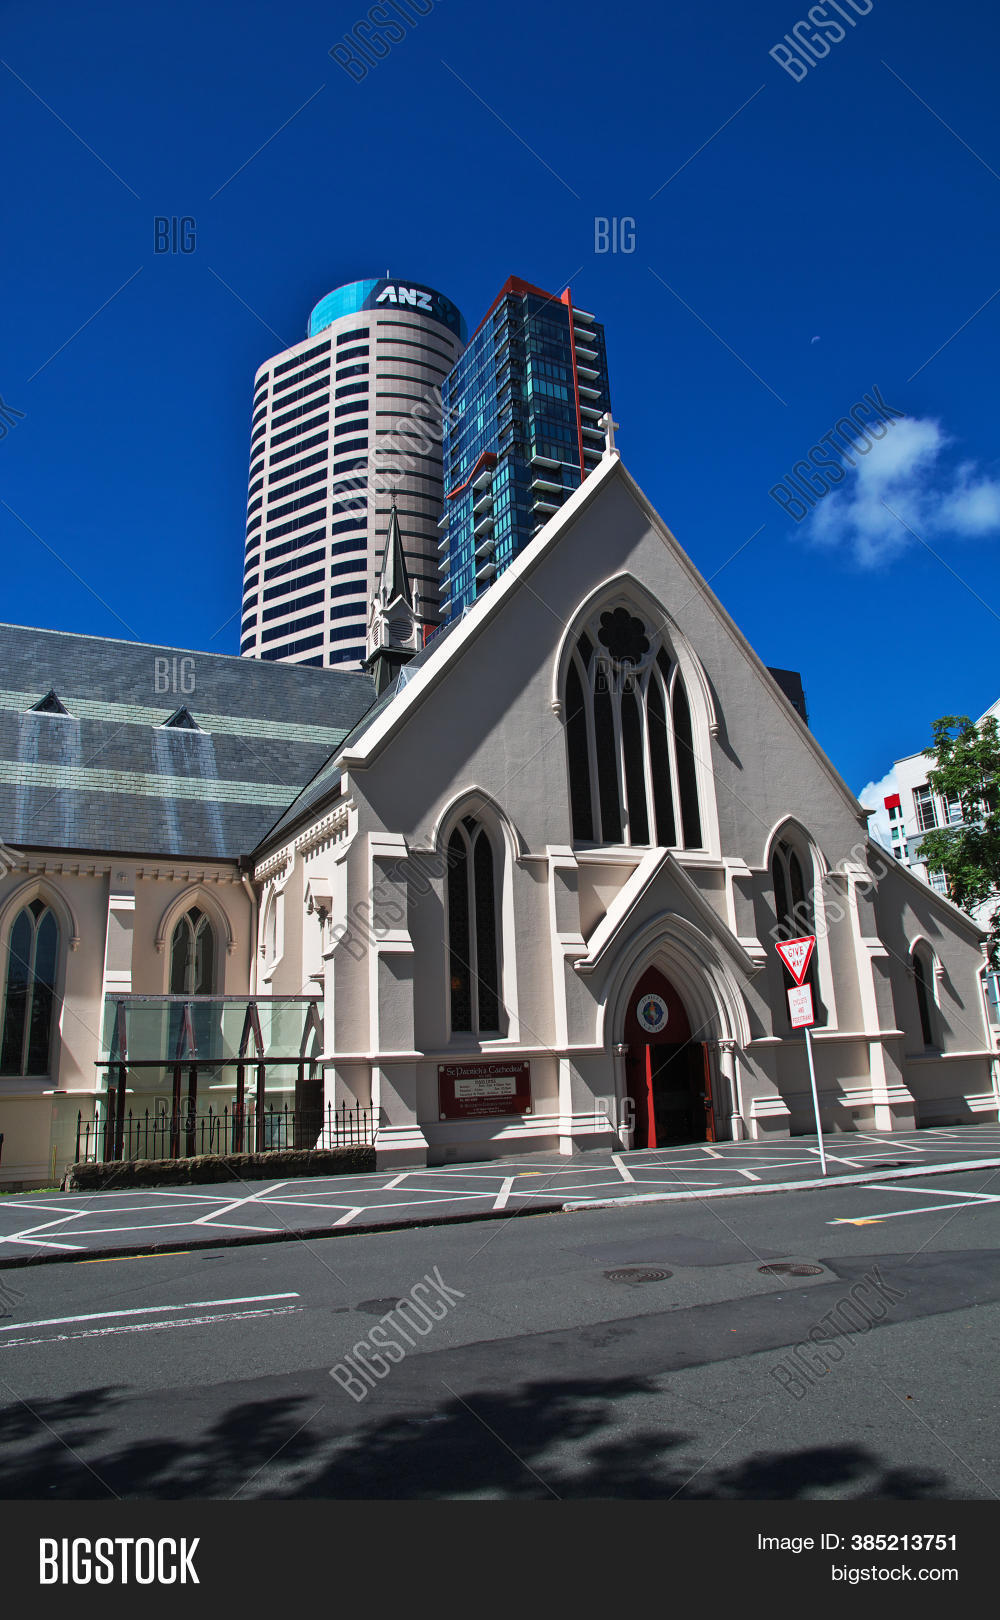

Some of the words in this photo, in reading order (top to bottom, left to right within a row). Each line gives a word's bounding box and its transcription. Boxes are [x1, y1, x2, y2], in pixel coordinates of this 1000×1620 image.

[376, 286, 432, 311] ANZ
[788, 945, 805, 958] GIVE
[792, 959, 803, 968] WAY
